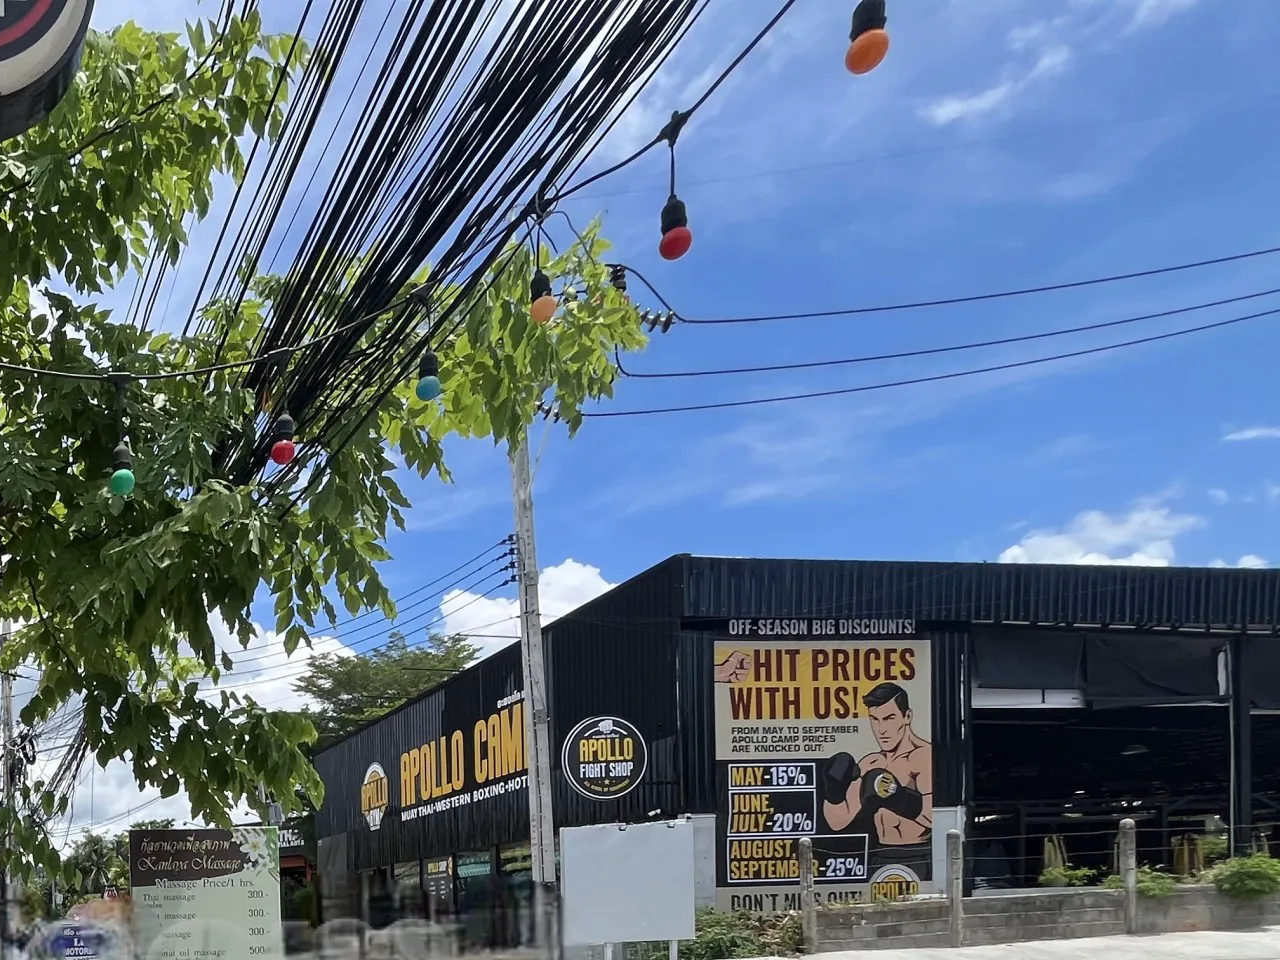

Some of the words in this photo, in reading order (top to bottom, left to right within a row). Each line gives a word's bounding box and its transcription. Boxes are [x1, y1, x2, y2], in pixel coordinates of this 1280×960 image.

[728, 619, 807, 635] OFF-SEASON
[811, 619, 835, 635] BIG
[839, 618, 916, 634] DISCOUNTS!
[753, 648, 801, 682] HIT
[811, 647, 916, 682] PRICES
[729, 686, 801, 720] WITH
[813, 685, 859, 720] US!
[787, 726, 800, 734] TO
[802, 726, 859, 734] SEPTEMBER
[731, 736, 768, 744] APOLLO
[771, 735, 800, 743] CAMP
[802, 735, 836, 743] PRICES
[754, 744, 800, 752] KNOCKED
[579, 737, 634, 762] APOLLO
[400, 728, 464, 808] APOLLO
[579, 763, 607, 778] FIGHT
[609, 762, 634, 777] SHOP
[731, 766, 807, 786] MAY-15%
[733, 794, 774, 814] JUNE,
[401, 808, 417, 822] MUAY
[730, 812, 812, 833] JULY-20%
[730, 840, 796, 860] AUGUST,
[191, 855, 241, 872] Massage
[730, 857, 864, 880] SEPTEMBR-25%
[155, 879, 198, 890] Massage
[202, 879, 235, 888] Price/1
[143, 893, 160, 902] Thai
[163, 894, 196, 903] massage
[247, 890, 269, 899] 300.-
[784, 891, 821, 911] MIS
[164, 913, 196, 921] massage
[248, 909, 270, 918] 300.-
[249, 927, 271, 936] 300.-
[179, 949, 190, 957] oil
[193, 949, 226, 958] massage
